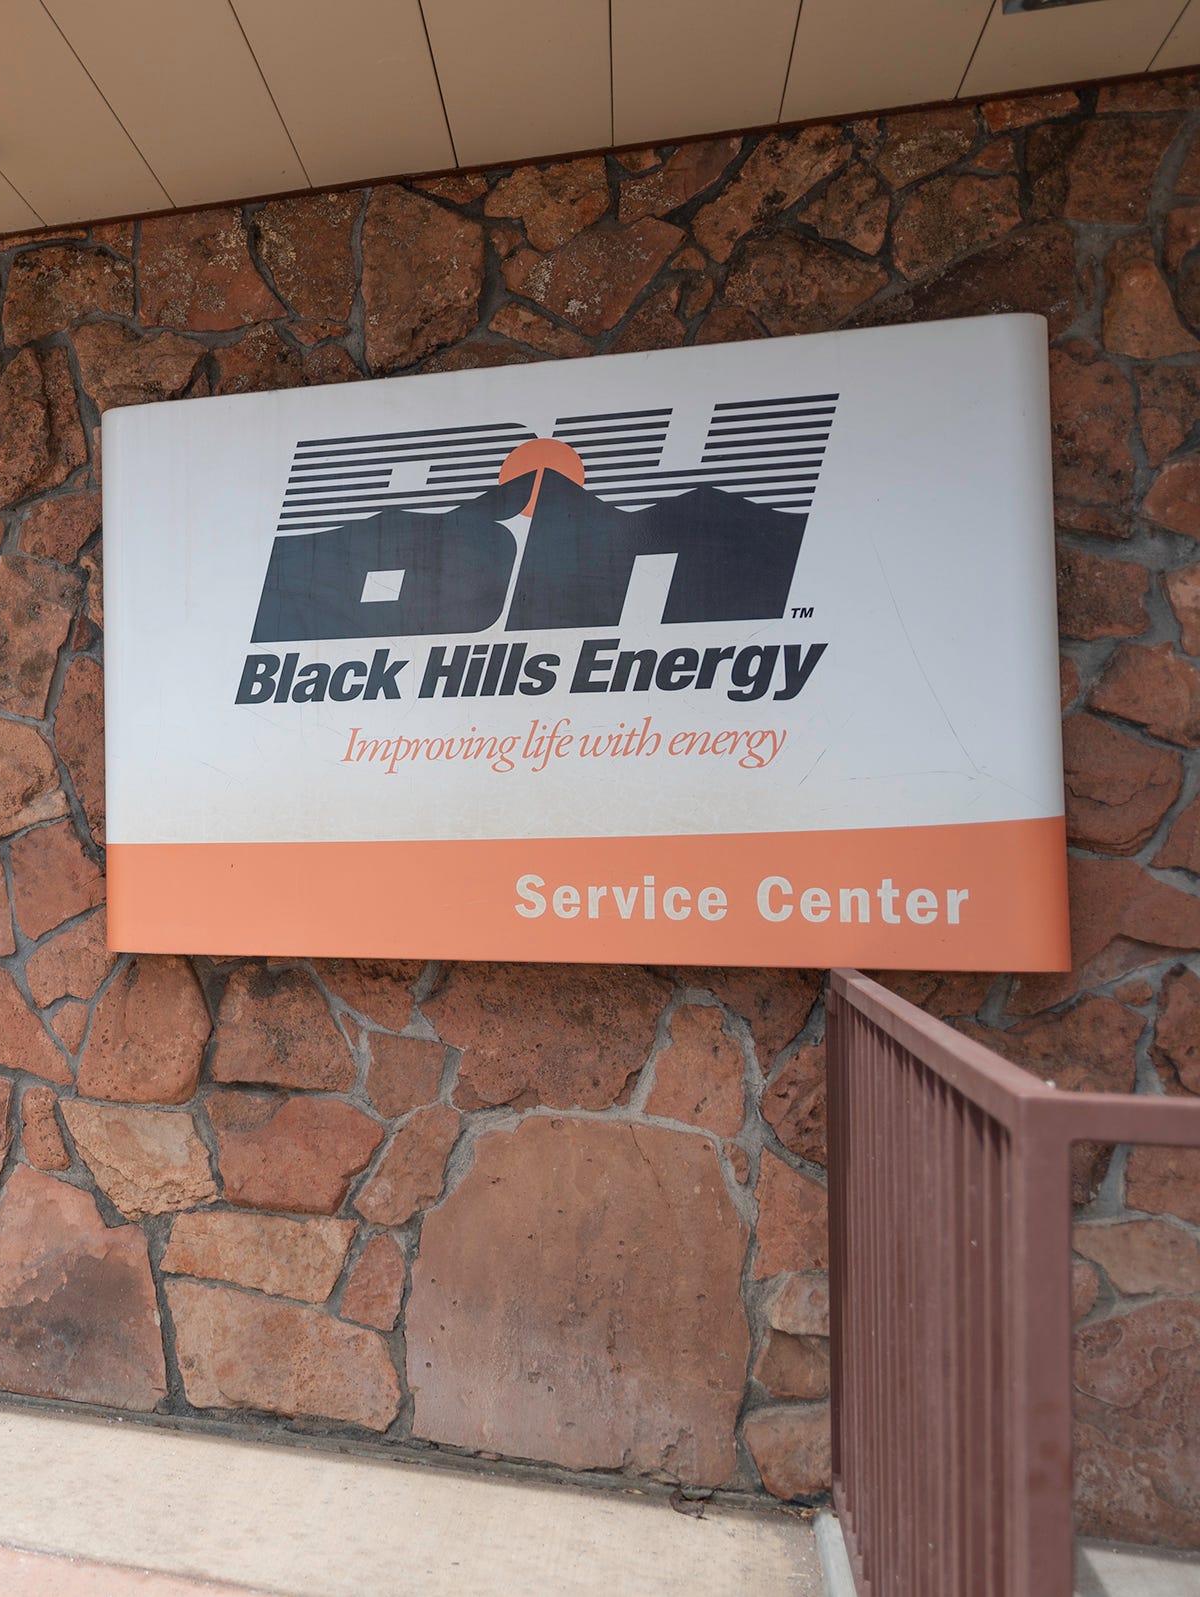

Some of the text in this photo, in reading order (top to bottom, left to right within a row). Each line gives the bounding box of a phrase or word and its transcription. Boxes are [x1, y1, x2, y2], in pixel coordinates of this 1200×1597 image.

[249, 393, 840, 643] BH
[234, 637, 828, 705] Black Hills Energy
[341, 717, 786, 773] Improving life with energy
[515, 875, 970, 925] Service Center
